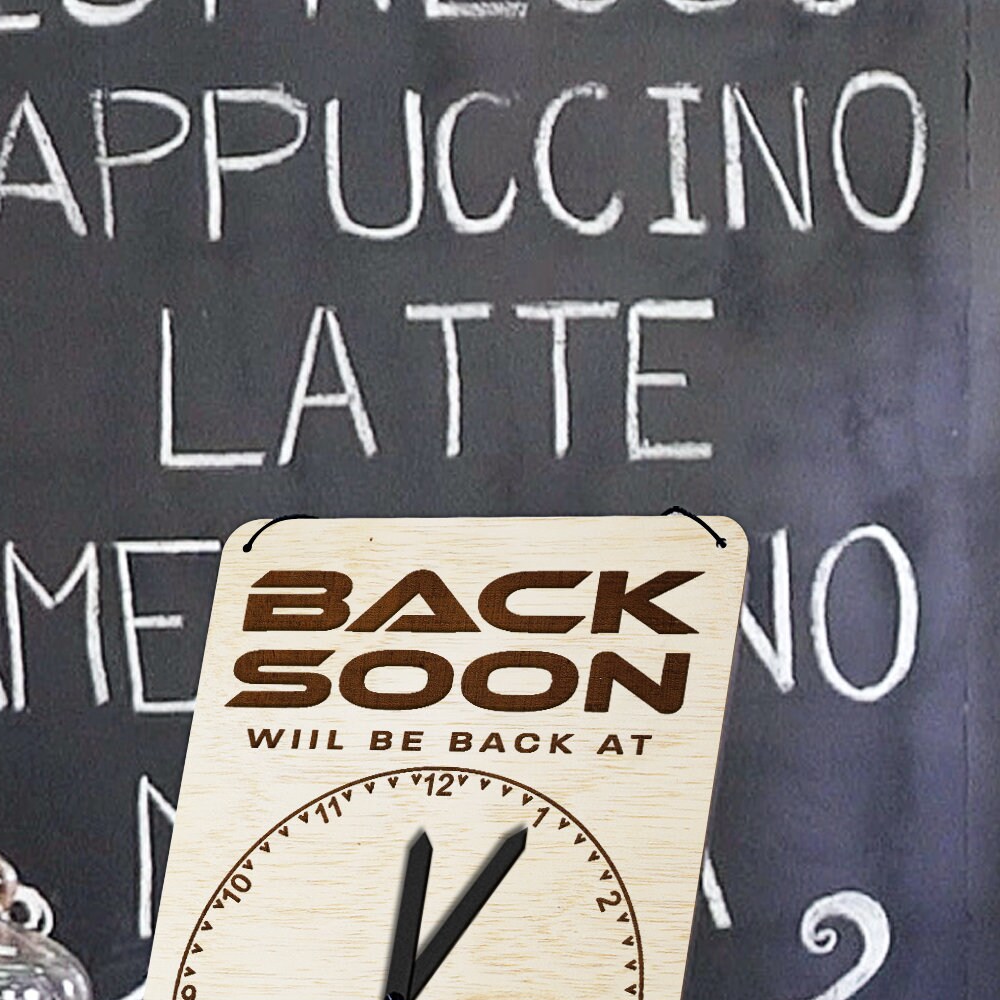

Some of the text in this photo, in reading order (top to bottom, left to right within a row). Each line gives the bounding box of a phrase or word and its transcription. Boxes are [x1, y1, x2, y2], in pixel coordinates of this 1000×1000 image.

[159, 298, 715, 469] LATTE
[242, 569, 706, 635] BACK
[224, 649, 691, 715] SOON
[369, 730, 424, 752] BE
[448, 731, 575, 755] BACK
[596, 734, 653, 756] AT
[424, 772, 455, 797] 12
[314, 796, 342, 824] 11
[532, 806, 550, 828] 1
[222, 873, 252, 904] 10
[595, 890, 622, 913] 2
